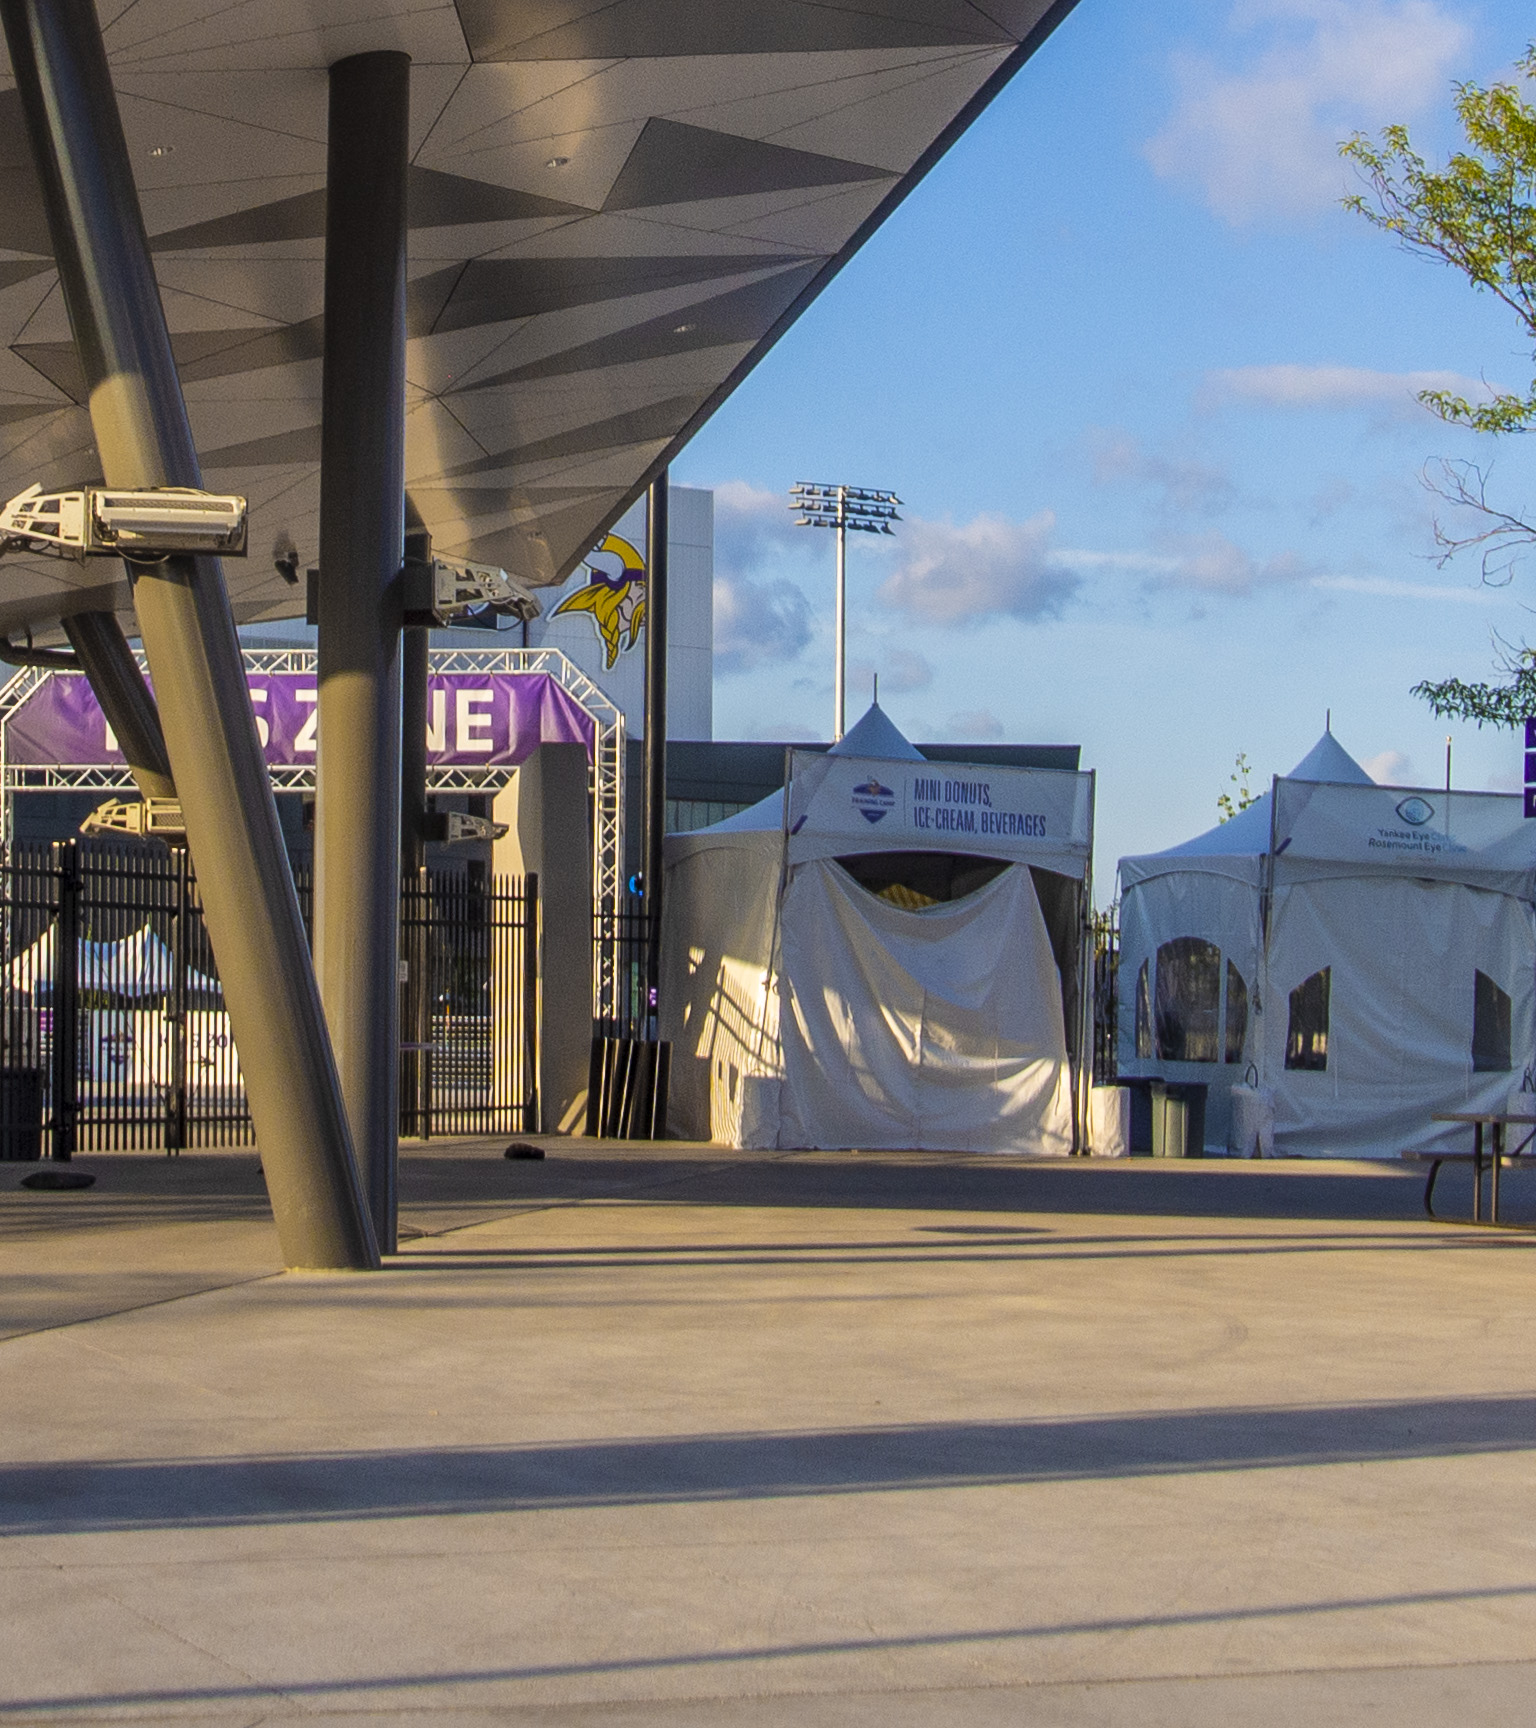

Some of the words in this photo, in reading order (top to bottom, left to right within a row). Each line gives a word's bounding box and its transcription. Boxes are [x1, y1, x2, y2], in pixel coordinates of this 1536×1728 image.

[295, 689, 494, 754] ZNE
[914, 778, 941, 802] MINI
[944, 780, 993, 808] DONUTS,
[914, 806, 979, 835] ICE-CREAM,
[981, 811, 1047, 837] BEVERAGES
[1377, 829, 1411, 839] Yankee
[1413, 830, 1430, 841] Eye
[1368, 838, 1422, 851] Rosemount
[1424, 840, 1442, 853] Eye
